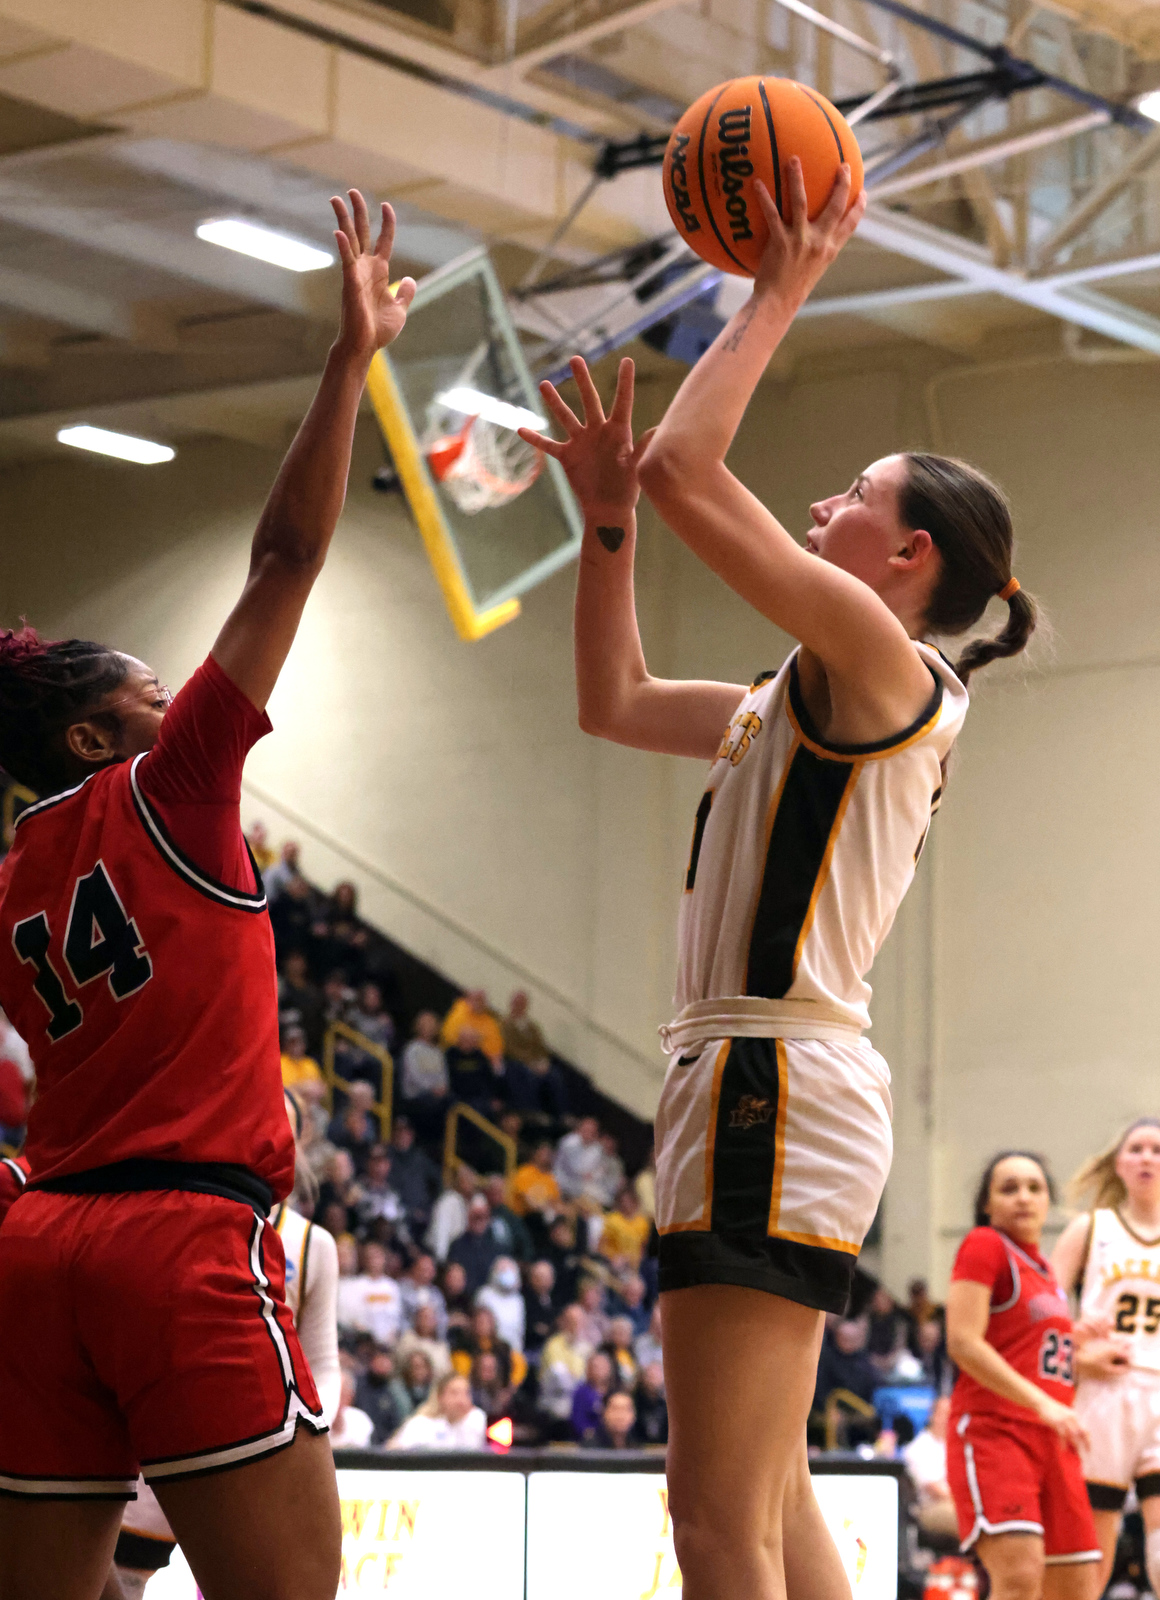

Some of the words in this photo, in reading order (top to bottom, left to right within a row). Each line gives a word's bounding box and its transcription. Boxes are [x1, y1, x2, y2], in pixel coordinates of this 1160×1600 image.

[670, 132, 701, 233] NCAA
[718, 105, 753, 242] Wilson
[11, 858, 153, 1045] 14
[1115, 1293, 1160, 1334] 25
